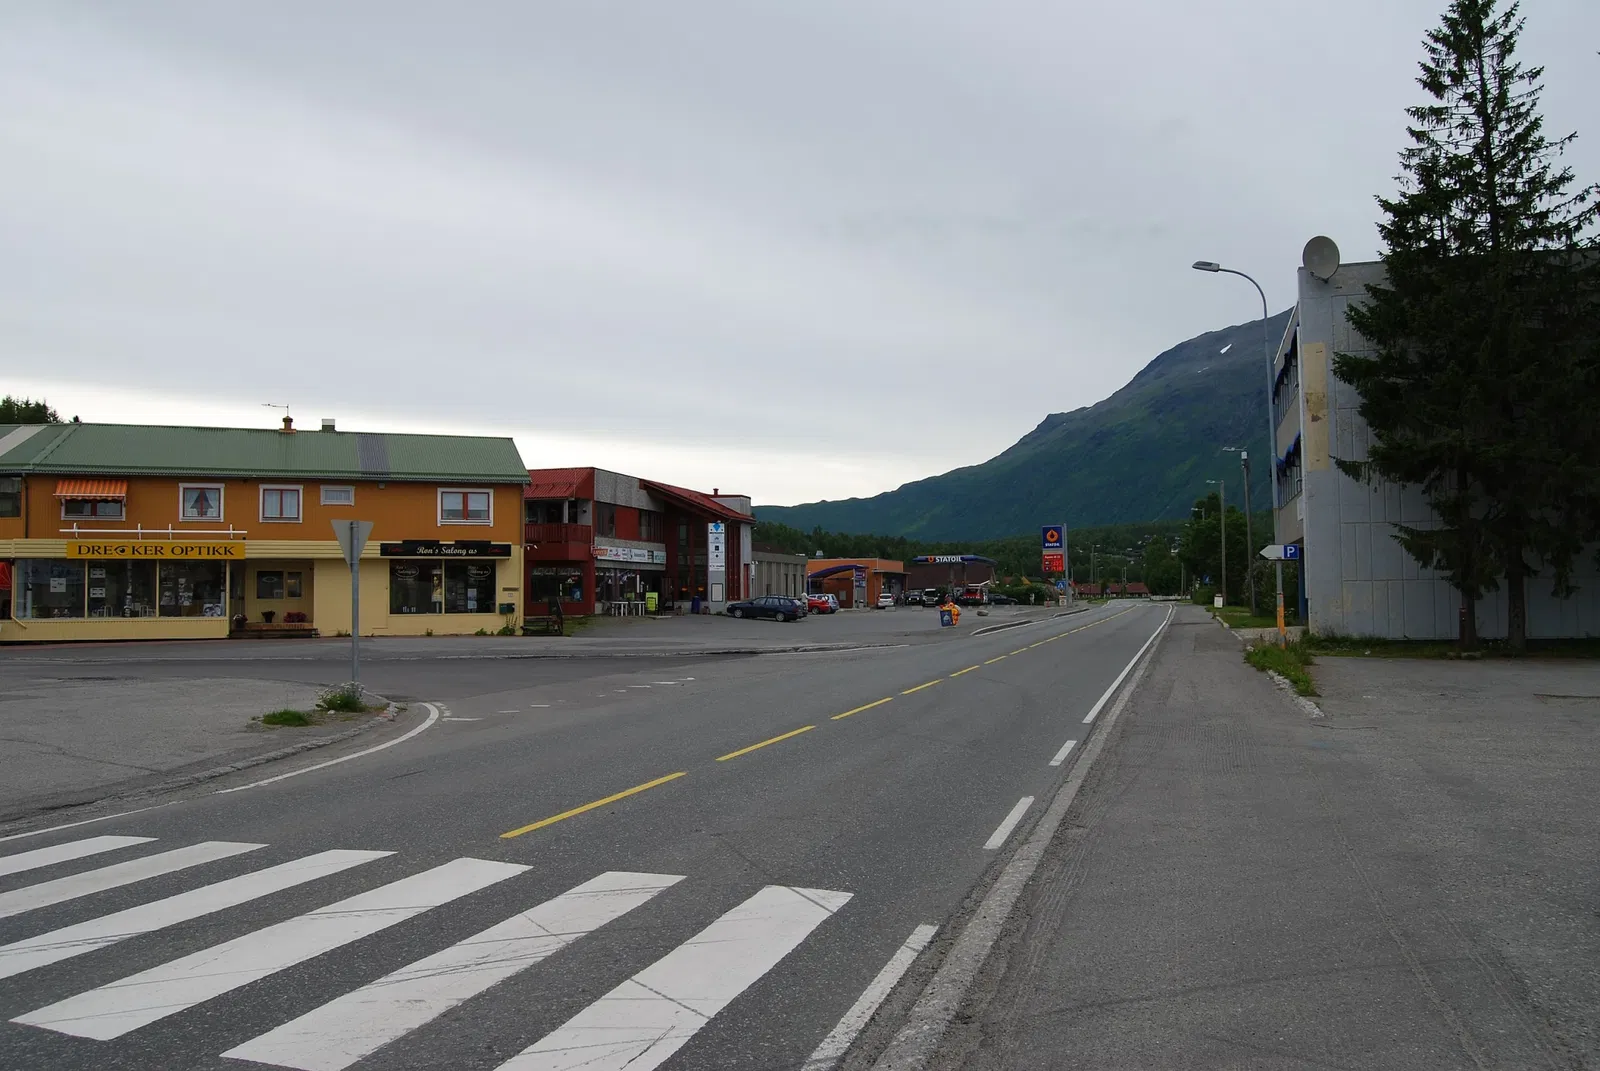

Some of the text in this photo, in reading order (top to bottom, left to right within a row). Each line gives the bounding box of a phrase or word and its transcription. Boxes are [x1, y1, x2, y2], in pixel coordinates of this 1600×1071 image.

[171, 545, 235, 556] OPTIKK
[417, 546, 439, 555] Ron's
[441, 546, 466, 556] Salong
[1287, 546, 1295, 557] P
